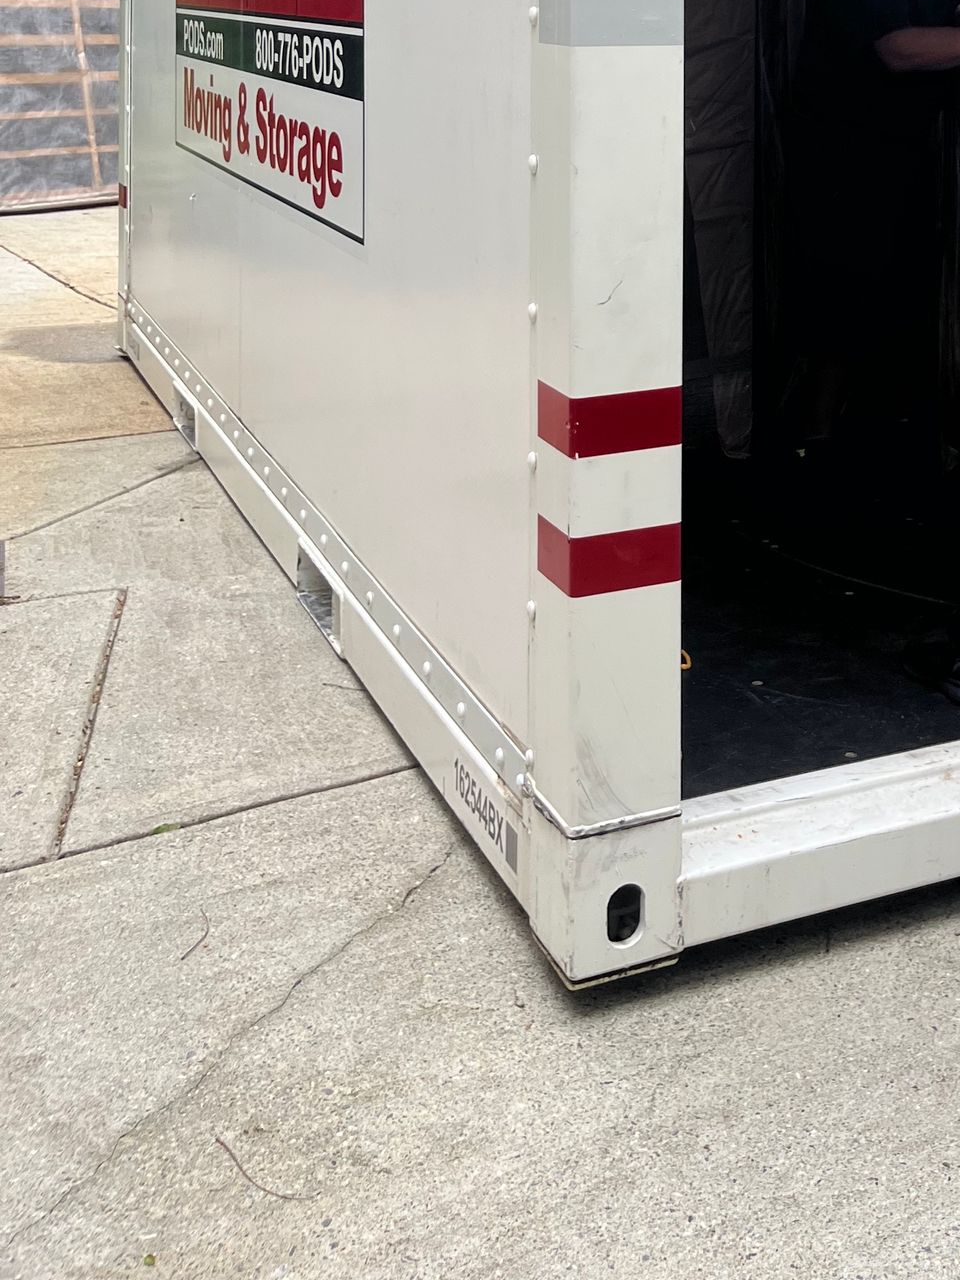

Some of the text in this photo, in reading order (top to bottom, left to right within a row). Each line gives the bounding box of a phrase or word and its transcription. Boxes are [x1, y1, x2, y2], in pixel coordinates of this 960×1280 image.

[183, 19, 344, 88] PODS.com 800-776-PODS
[183, 66, 344, 210] Moving & Storage
[454, 757, 504, 854] 162544BX
